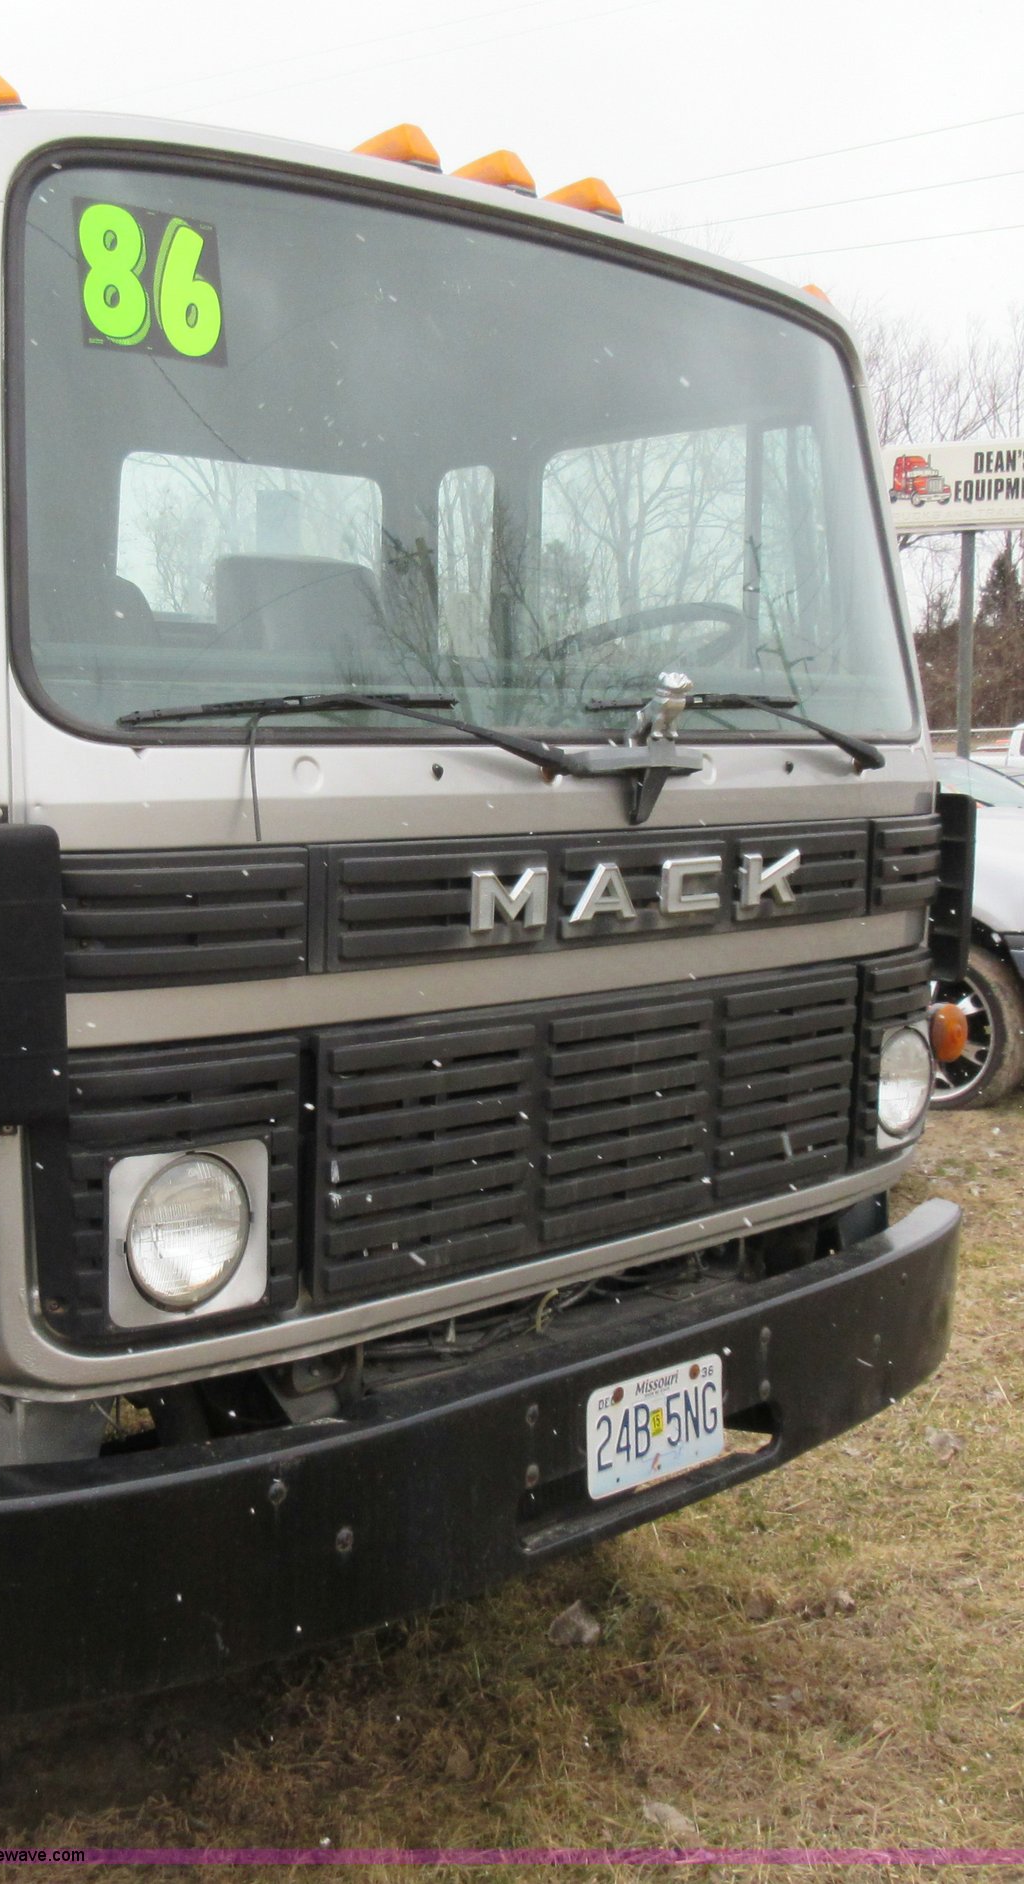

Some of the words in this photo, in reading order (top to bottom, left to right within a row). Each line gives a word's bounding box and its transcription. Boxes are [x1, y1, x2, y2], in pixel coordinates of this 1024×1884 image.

[79, 203, 222, 358] 86
[973, 448, 1024, 474] DEAN'
[470, 848, 801, 933] MACK
[635, 1369, 679, 1396] Missouri
[596, 1402, 651, 1473] 24B
[666, 1381, 718, 1447] 5NG
